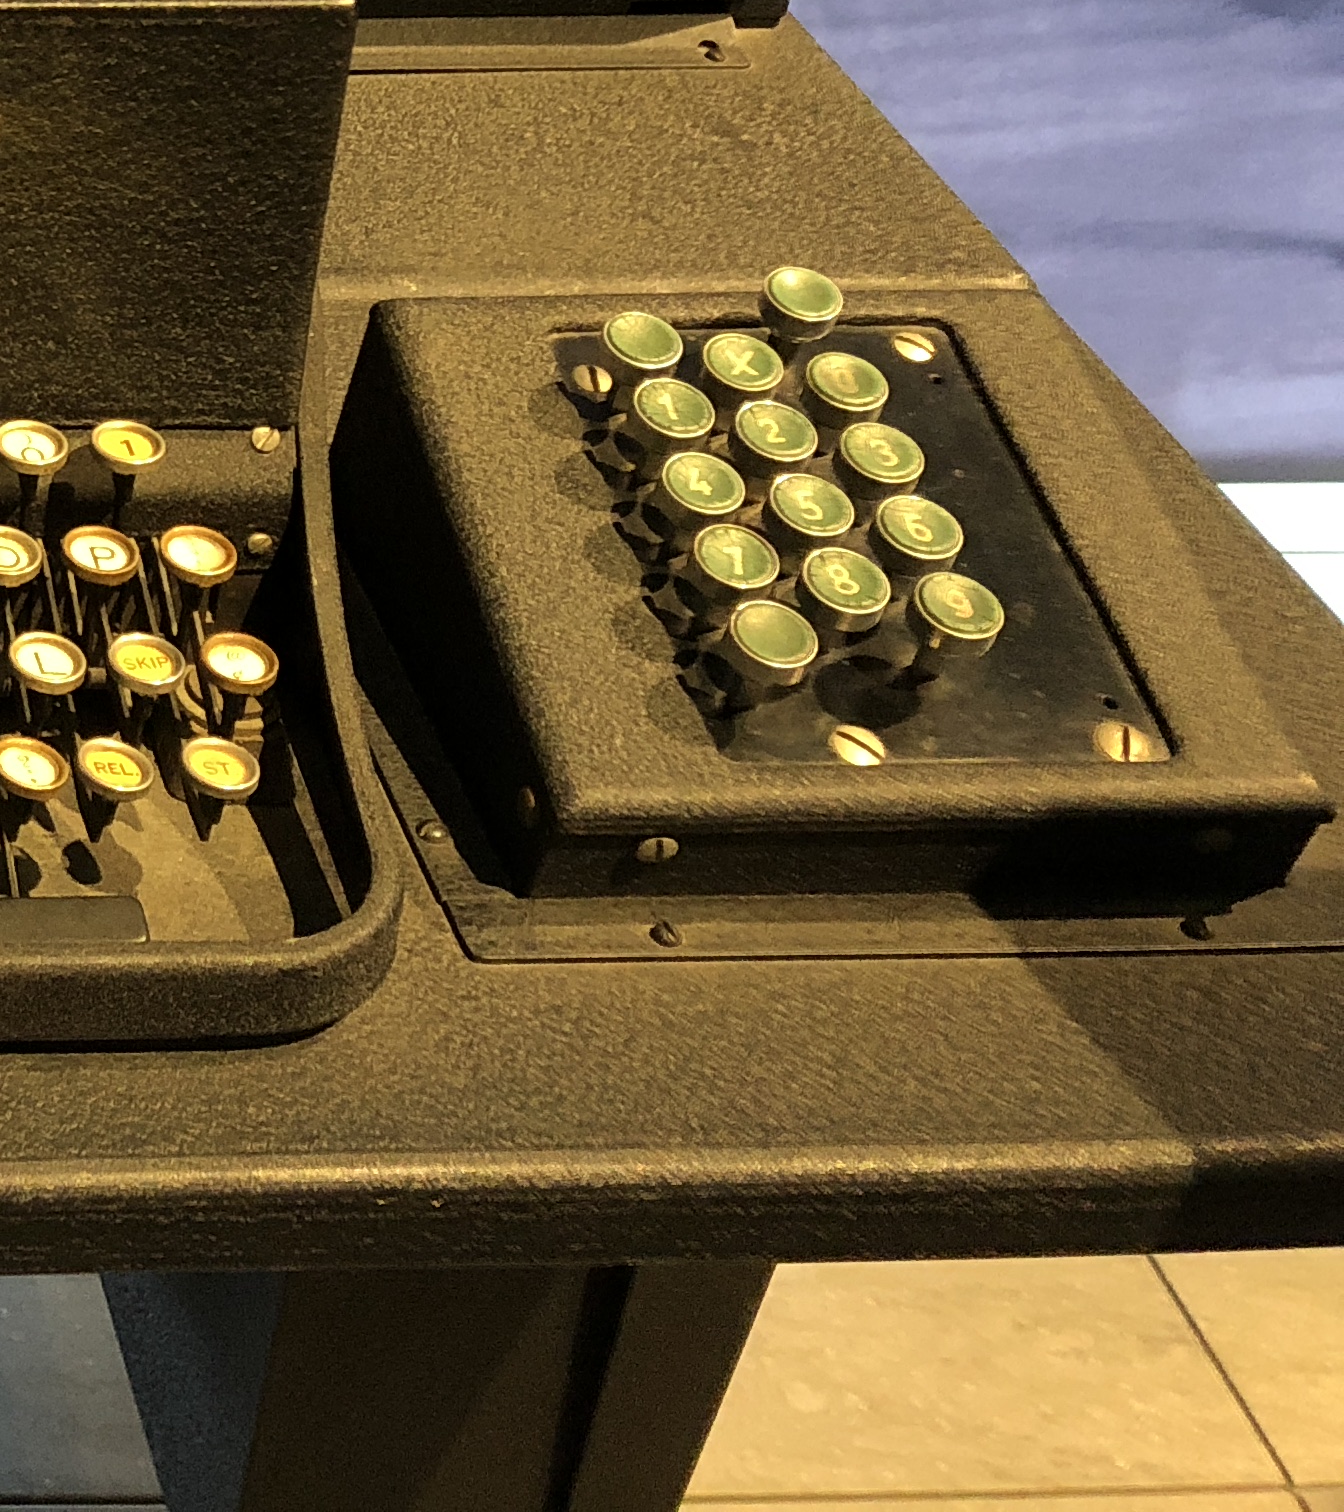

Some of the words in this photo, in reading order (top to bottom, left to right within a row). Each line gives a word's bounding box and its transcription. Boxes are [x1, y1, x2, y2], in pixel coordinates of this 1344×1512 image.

[724, 349, 760, 376] X
[658, 393, 680, 420] 1
[756, 417, 787, 444] 2
[869, 438, 901, 467] 3
[120, 439, 136, 457] 1
[690, 467, 713, 496] 4
[795, 489, 824, 521] 5
[903, 510, 934, 542] 6
[89, 545, 115, 570] P
[722, 546, 745, 576] 7
[827, 563, 861, 596] 8
[945, 588, 975, 619] 9
[33, 652, 68, 676] L
[122, 655, 171, 671] SKIP
